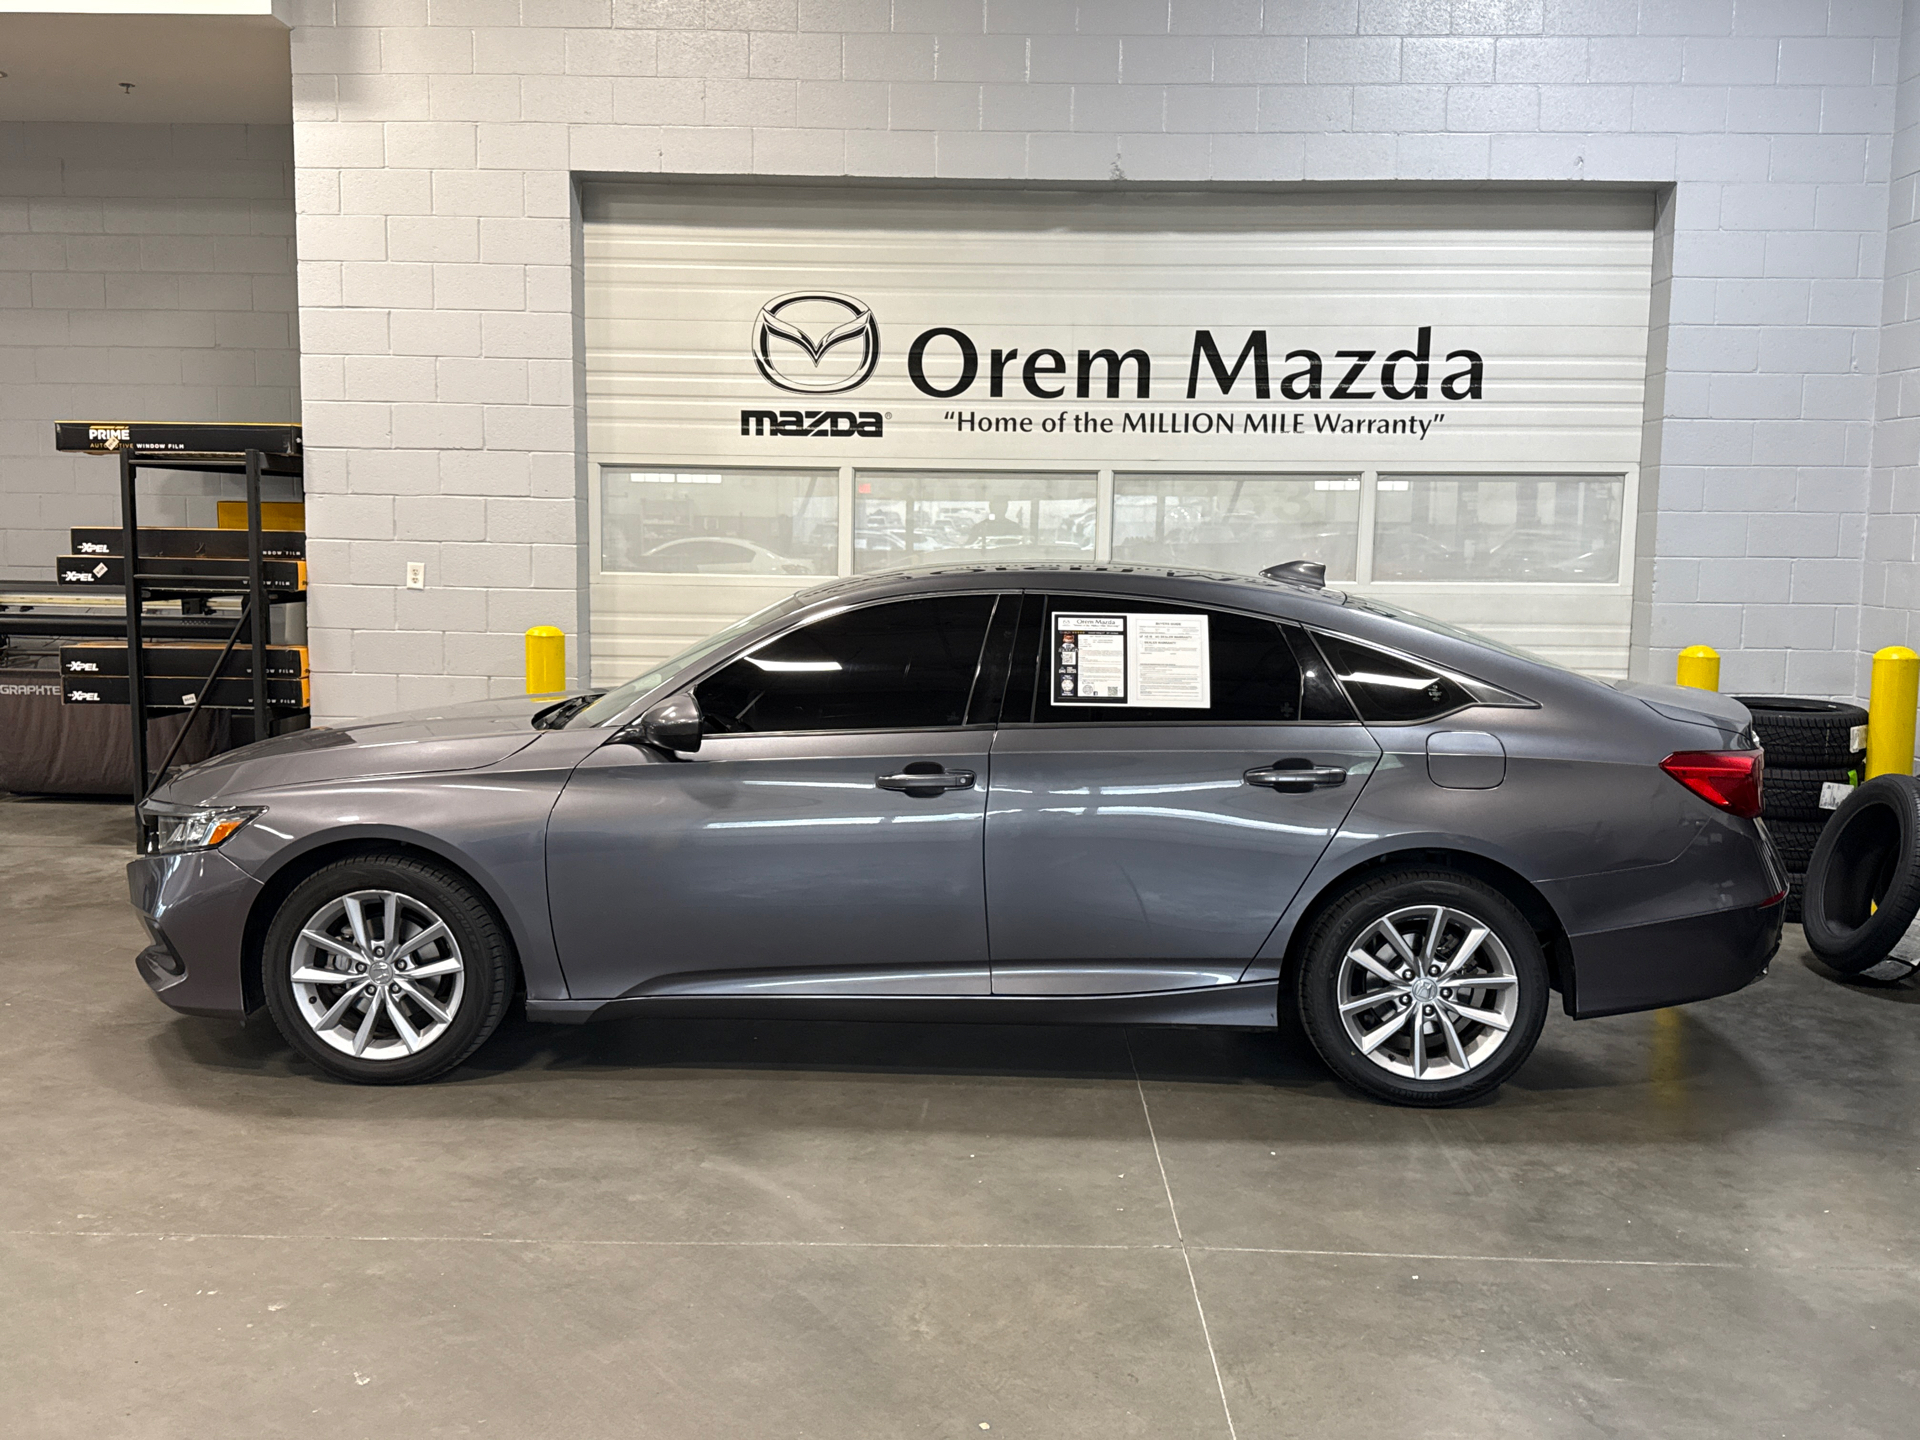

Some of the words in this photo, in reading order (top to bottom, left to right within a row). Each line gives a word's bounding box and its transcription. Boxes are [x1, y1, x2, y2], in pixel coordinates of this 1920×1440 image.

[907, 327, 1151, 399] Orem
[1187, 326, 1484, 401] Mazda
[944, 411, 1033, 433] “Home
[1041, 411, 1068, 433] of
[1073, 412, 1114, 433] the
[1122, 413, 1234, 434] MILLION
[1244, 413, 1305, 434] MILE
[1314, 413, 1445, 440] Warranty”
[89, 429, 130, 440] PRIME
[80, 542, 110, 553] XPEL
[64, 571, 95, 582] XPEL
[69, 661, 99, 671] XPEL
[70, 691, 101, 701] XPEL
[437, 894, 480, 951] HERCULES
